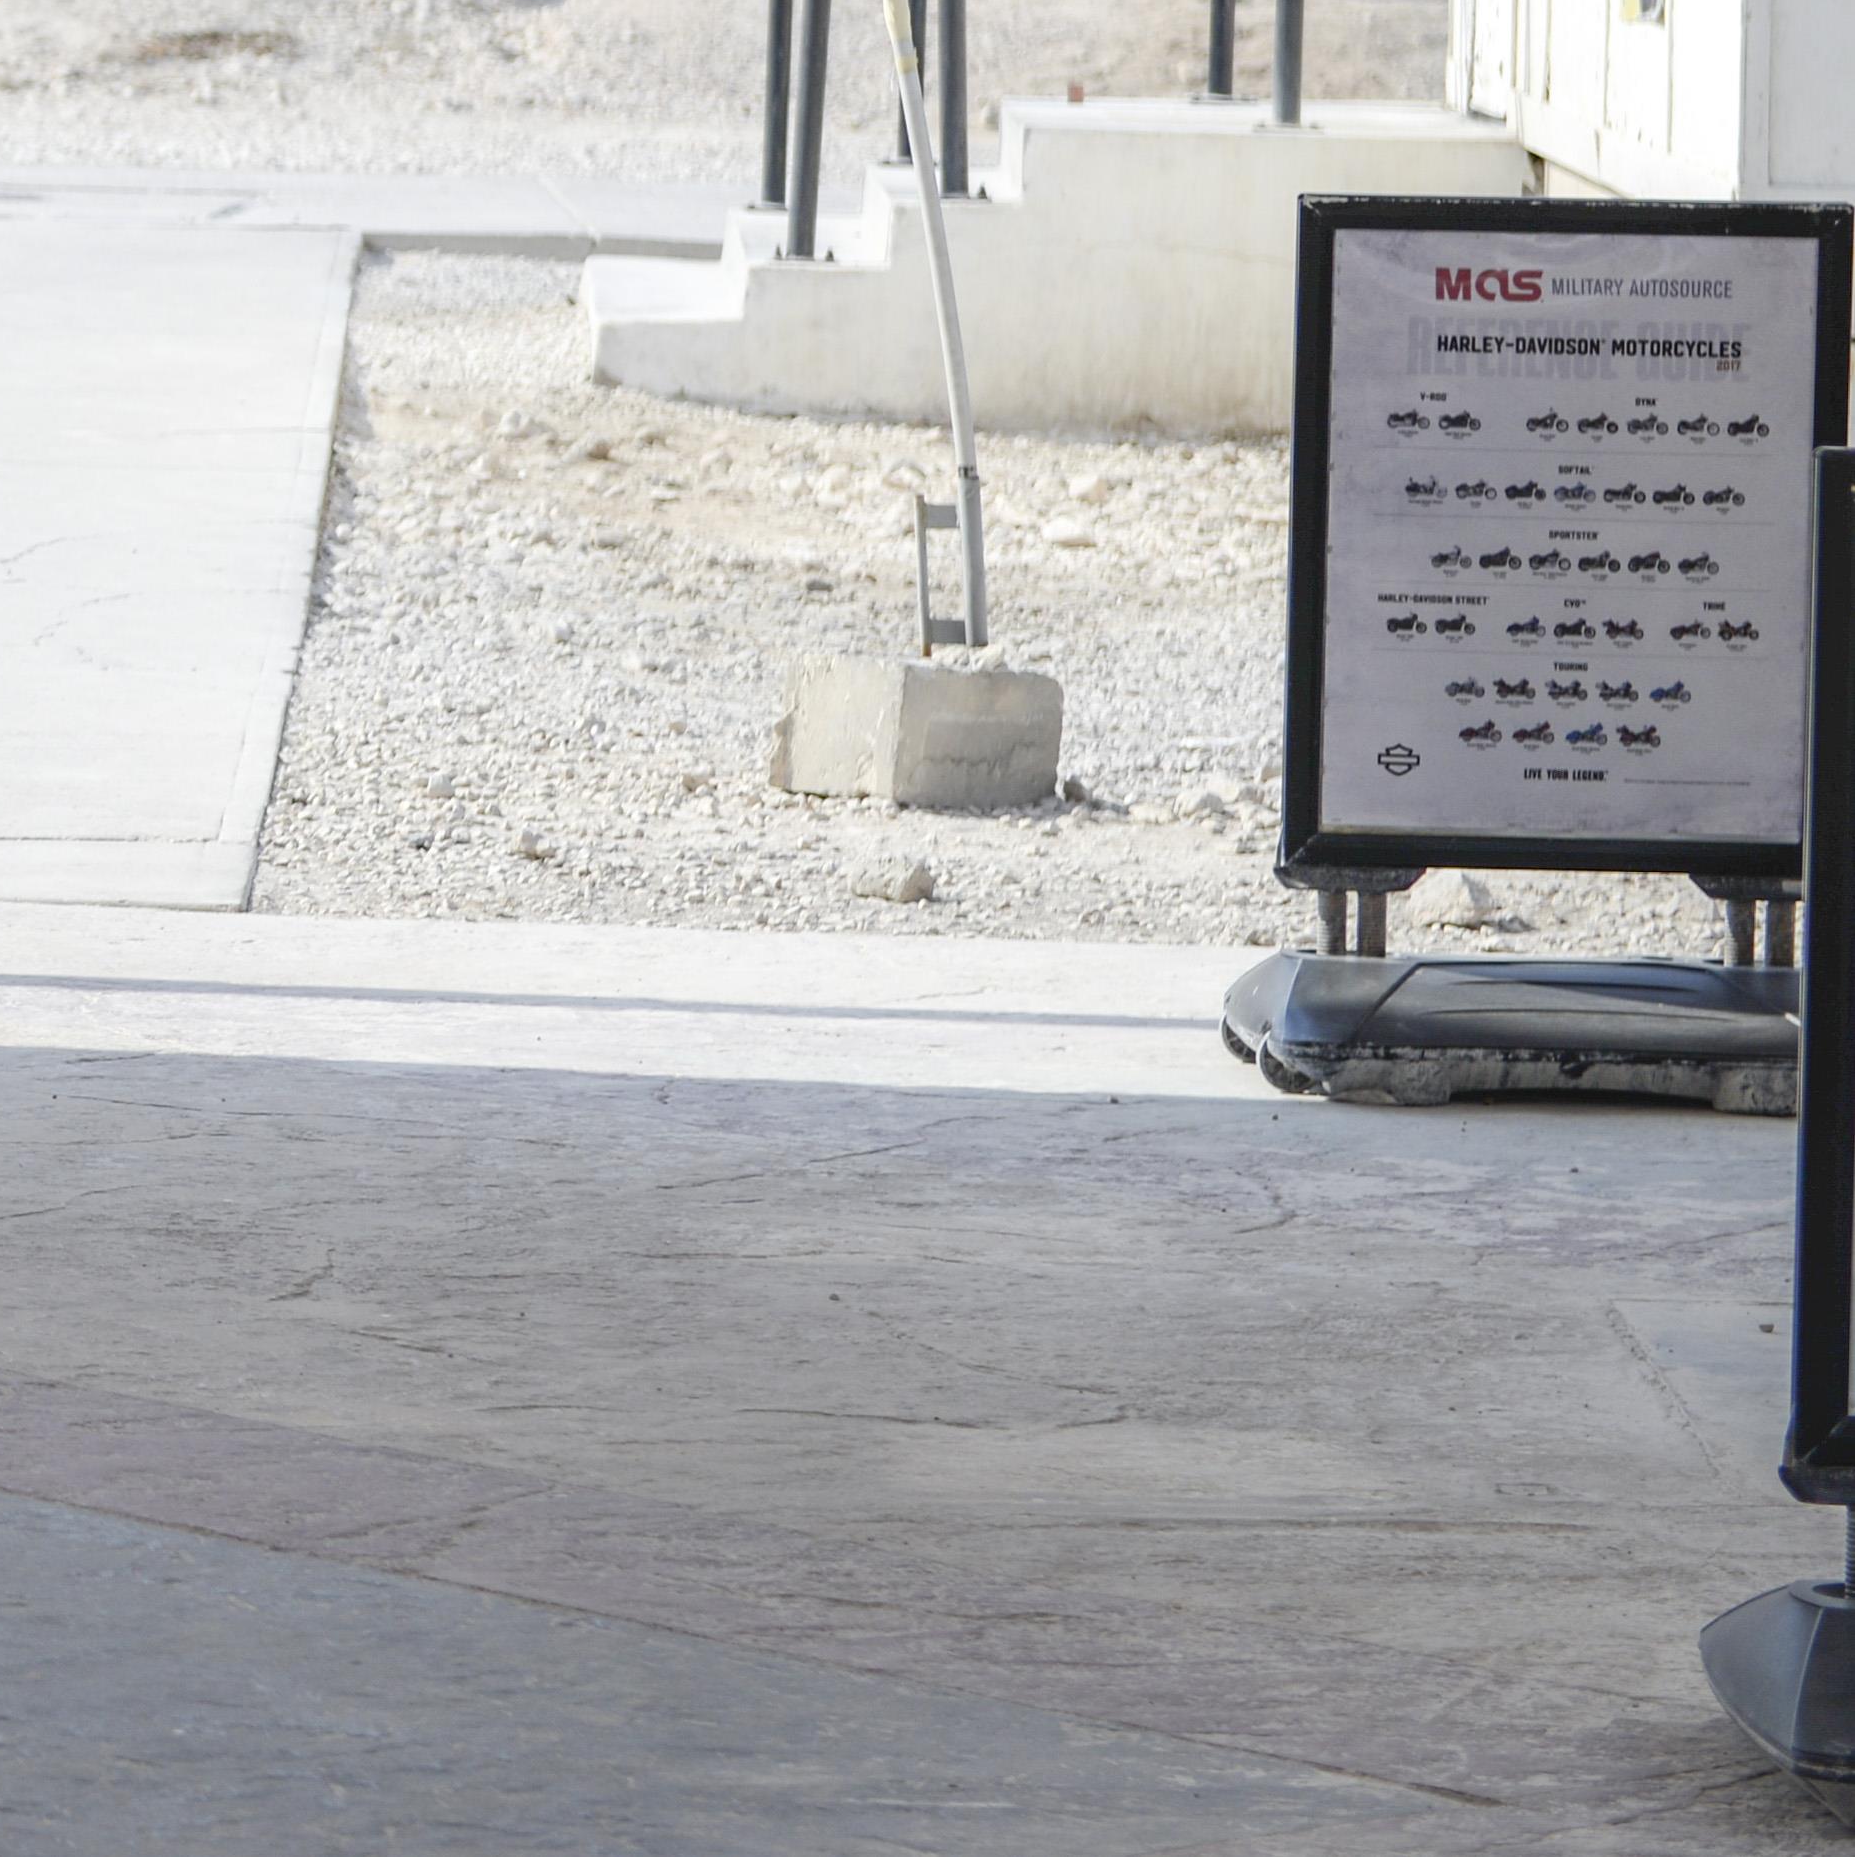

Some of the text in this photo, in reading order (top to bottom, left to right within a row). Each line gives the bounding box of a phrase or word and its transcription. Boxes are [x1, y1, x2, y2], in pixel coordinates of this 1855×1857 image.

[1551, 278, 1623, 296] MILITARY
[1629, 279, 1733, 299] AUTOSOURCE
[1611, 339, 1742, 359] MOTORCYCLES
[1716, 360, 1741, 372] 2017
[1554, 661, 1588, 671] TOURING
[1524, 768, 1541, 780] LIVE
[1547, 769, 1568, 781] YOUR
